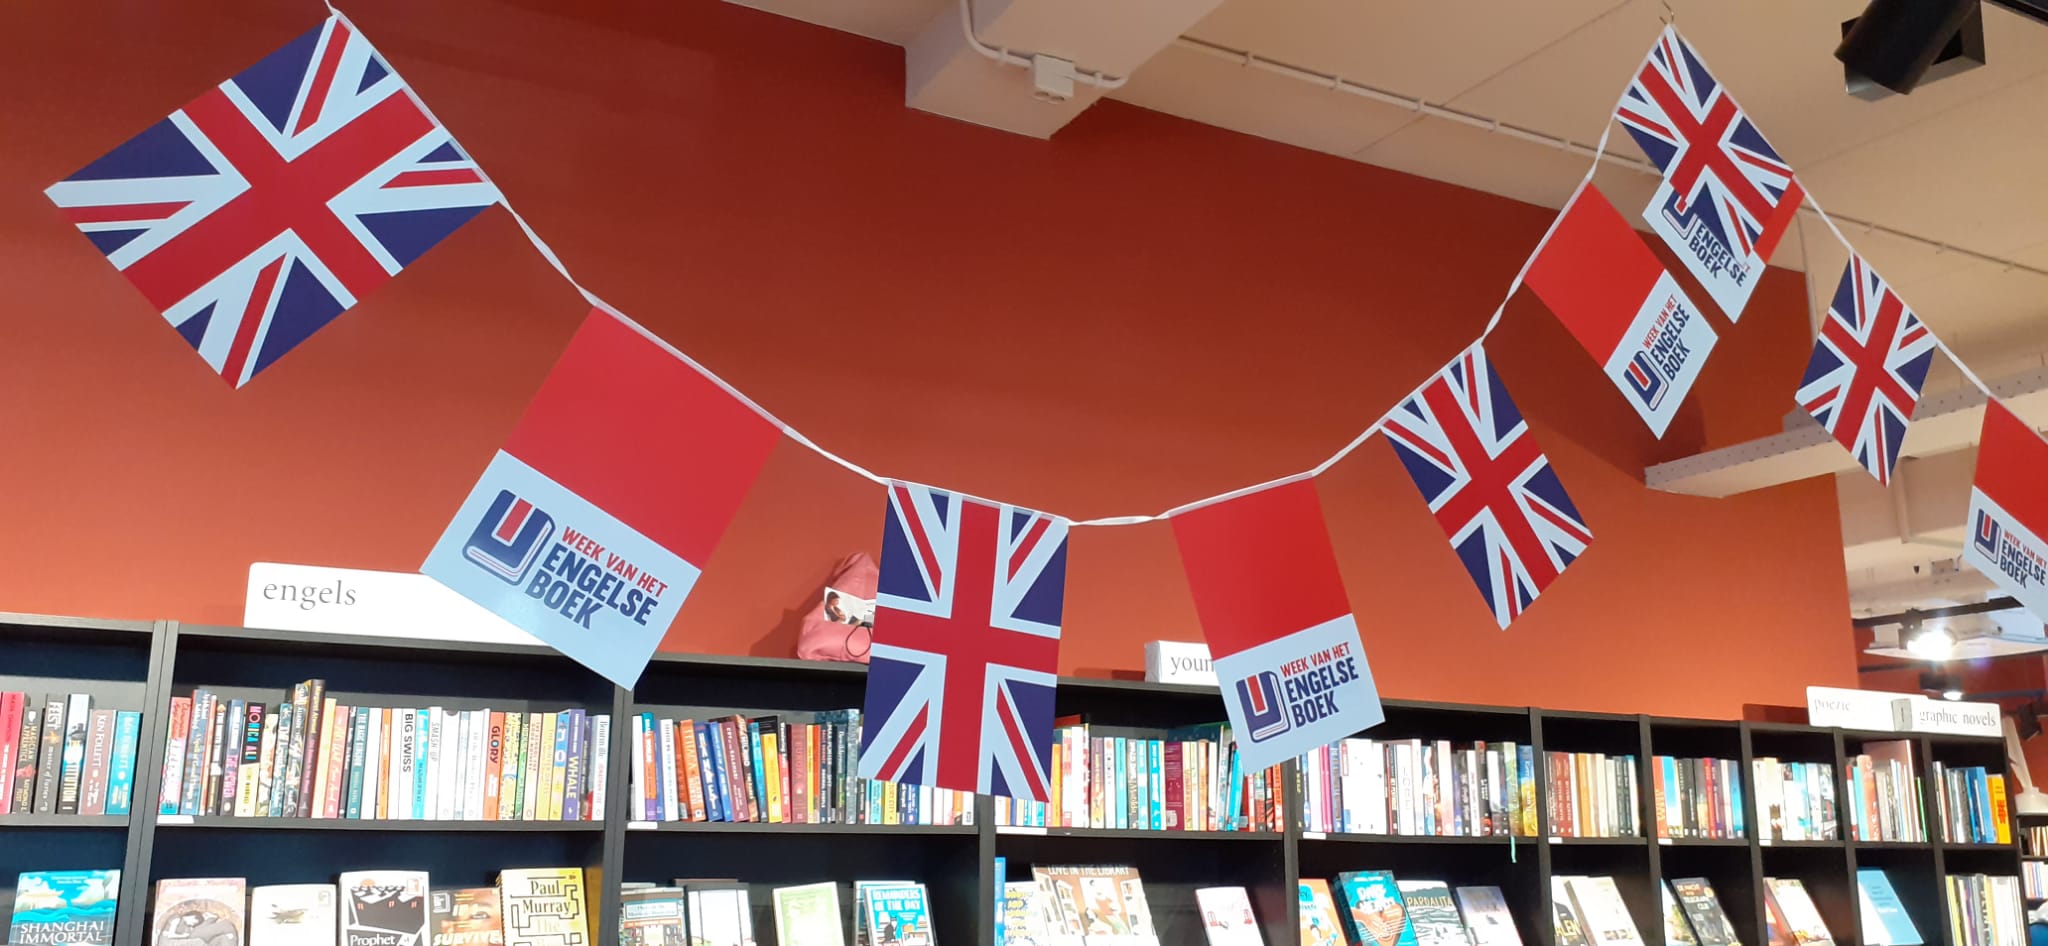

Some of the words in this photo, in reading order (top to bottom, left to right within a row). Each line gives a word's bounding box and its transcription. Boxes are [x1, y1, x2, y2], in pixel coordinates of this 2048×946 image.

[1689, 237, 1722, 279] BOEK
[1695, 224, 1747, 288] ENGELSE
[1642, 324, 1661, 349] WEEK
[1655, 308, 1670, 329] VAN
[1665, 294, 1678, 312] HET
[1650, 303, 1690, 366] ENGELSE
[1663, 338, 1691, 382] BOEK
[562, 526, 605, 561] WEEK
[606, 553, 638, 581] VAN
[637, 572, 668, 598] HET
[2004, 529, 2020, 548] WEEK
[2022, 545, 2036, 560] VAN
[2000, 555, 2027, 589] BOEK
[2001, 540, 2047, 586] ENGELSE
[263, 580, 357, 610] engels
[525, 569, 603, 630] BOEK
[542, 542, 659, 626] ENGELSE
[1280, 659, 1309, 678] WEEK
[1310, 649, 1332, 667] VAN
[1333, 641, 1351, 659] HET
[1285, 656, 1360, 704] ENGELSE
[47, 702, 64, 730] FEIST
[97, 714, 108, 732] KEN
[247, 706, 262, 743] MONICA
[404, 713, 414, 733] BIG
[1292, 690, 1339, 728] BOEK
[1920, 710, 1958, 727] graphic
[1963, 711, 1996, 727] novels
[92, 733, 105, 769] FOLLETT
[245, 746, 257, 760] ALI
[431, 722, 440, 749] SMASH
[490, 726, 501, 764] GLORY
[403, 735, 413, 773] SWISS
[430, 751, 438, 762] UP
[567, 754, 579, 799] WHALE
[531, 880, 560, 895] Paul
[1407, 896, 1453, 907] PARDALITA
[523, 899, 571, 914] Murray
[20, 931, 103, 945] IMMORTAL
[21, 921, 104, 934] SHANGHAI
[350, 933, 396, 946] Prophet
